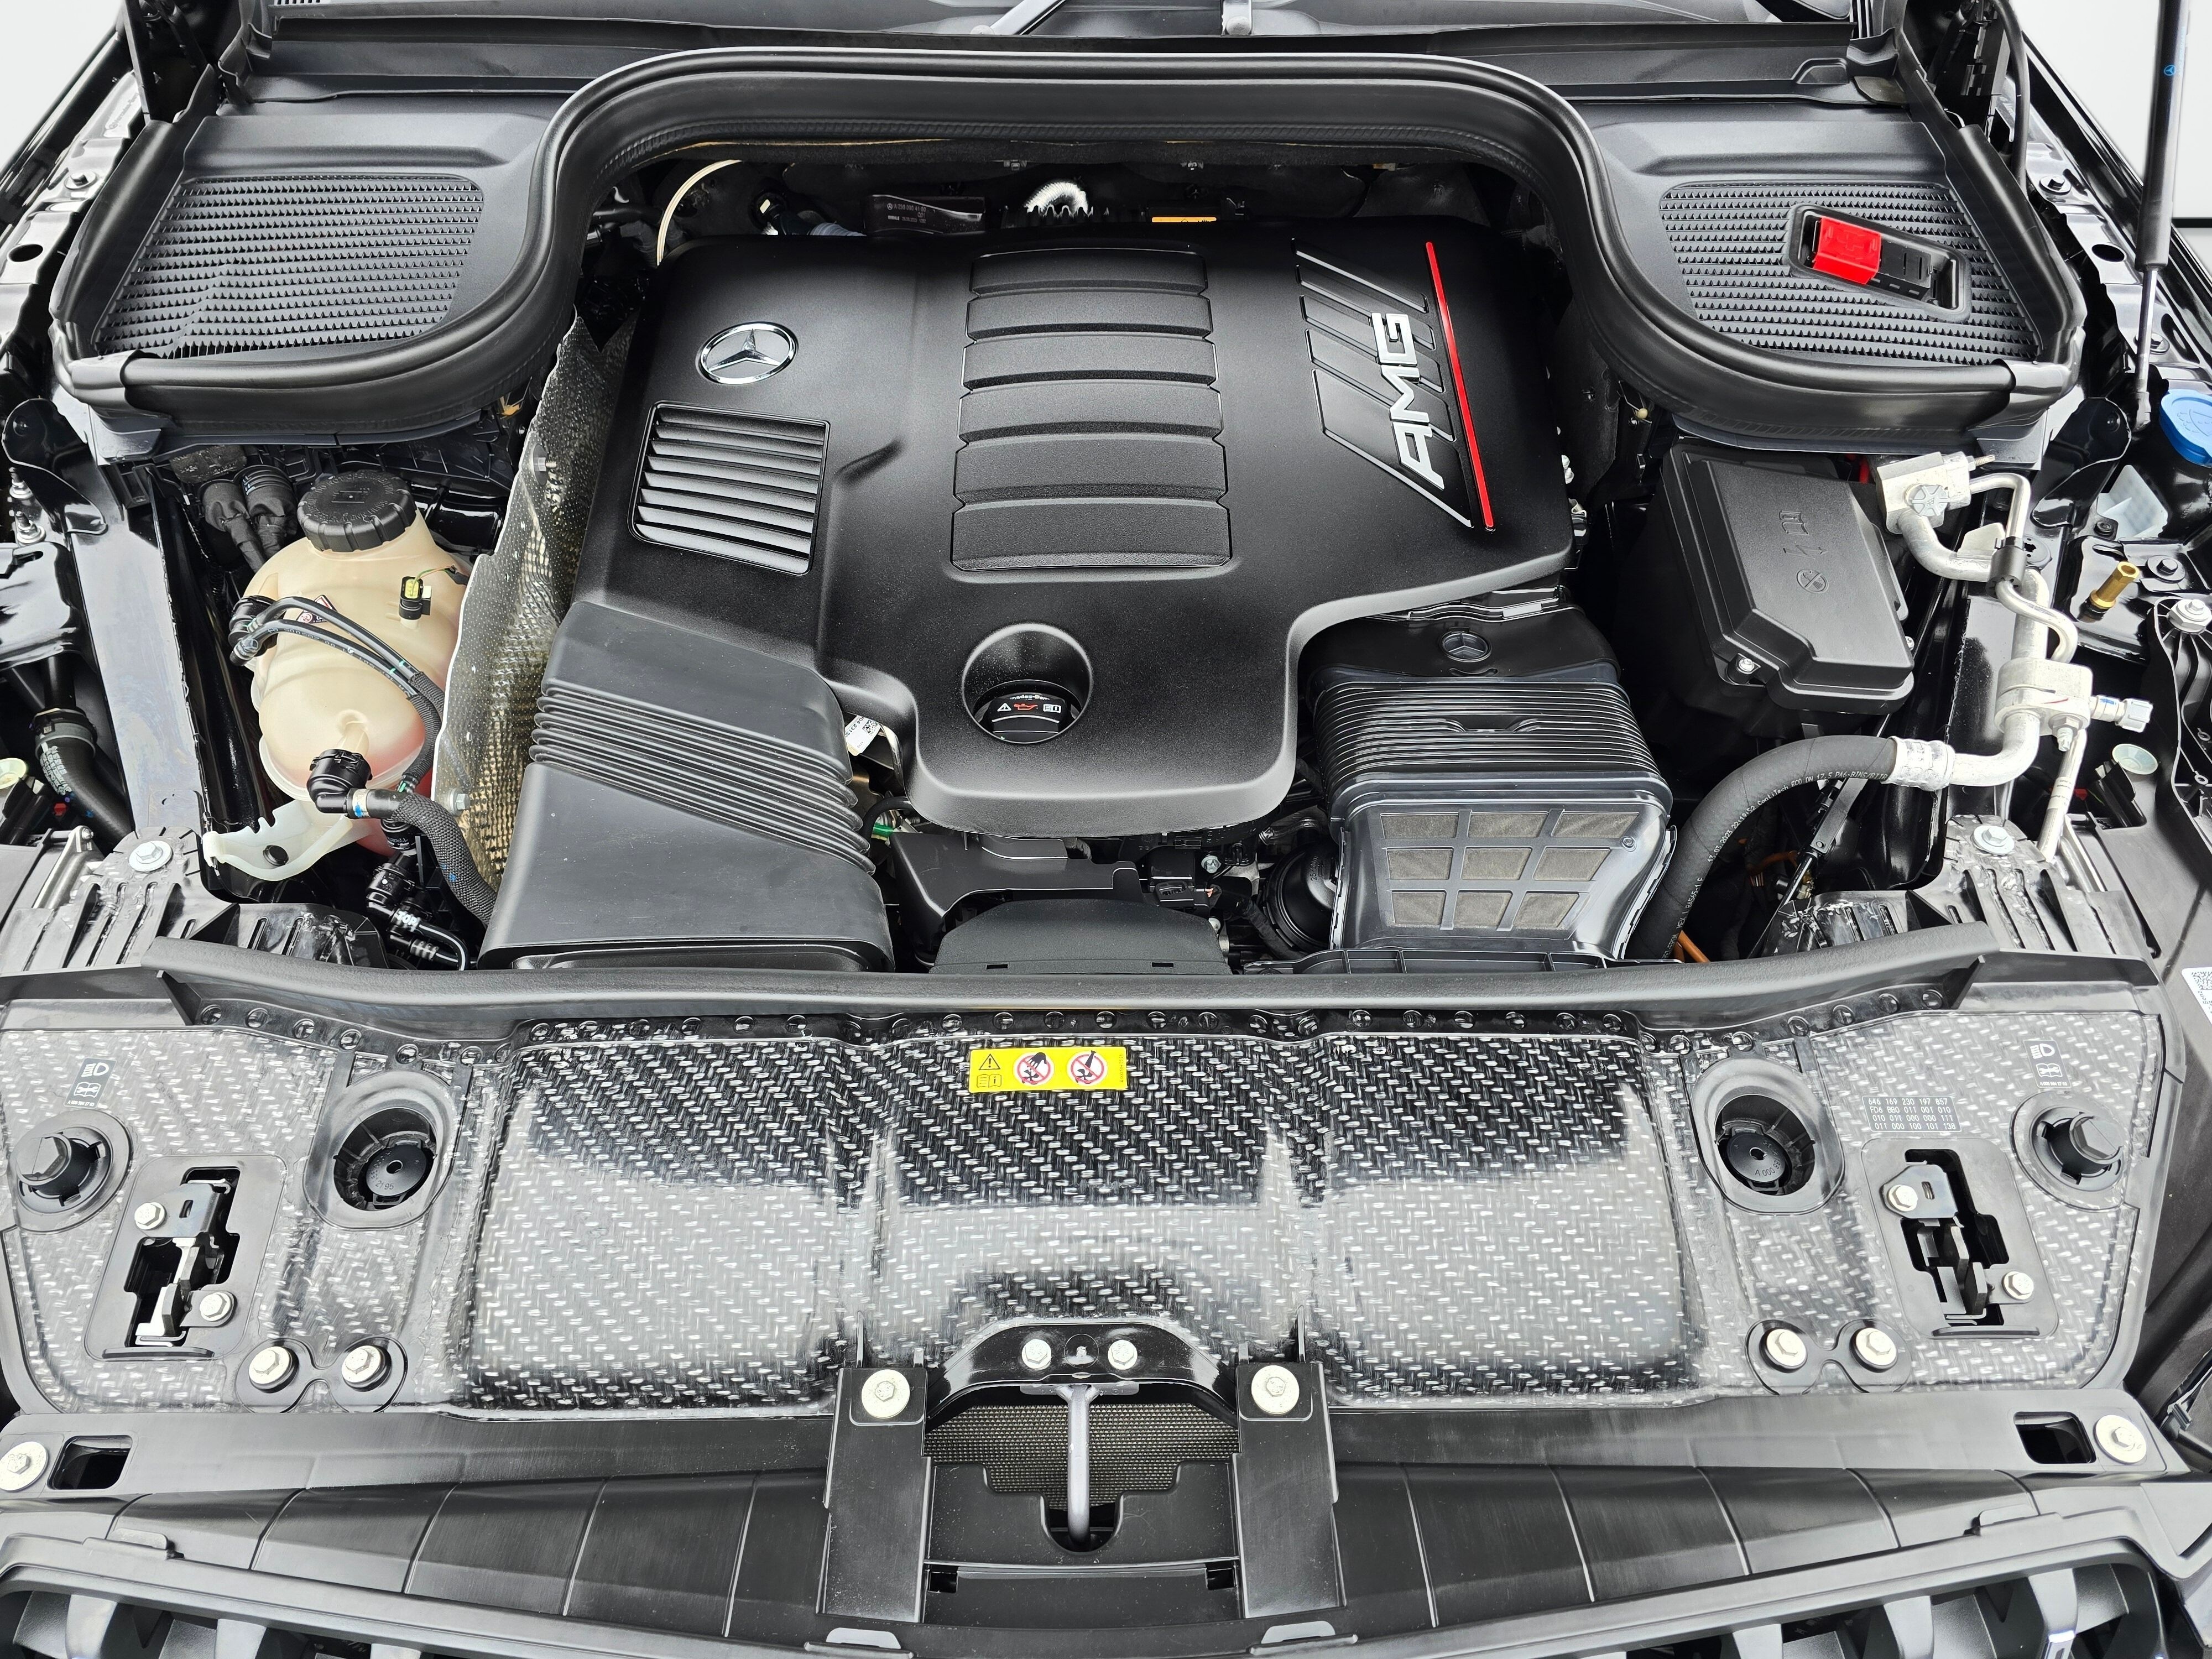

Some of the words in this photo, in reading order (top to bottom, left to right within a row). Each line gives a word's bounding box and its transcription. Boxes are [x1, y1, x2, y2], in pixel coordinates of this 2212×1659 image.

[1371, 312, 1445, 490] AMG
[1707, 830, 1733, 863] 13.03.2023
[1731, 805, 1756, 830] 22:19:52
[1757, 785, 1789, 806] ContiTech
[1791, 778, 1803, 787] ECO
[1816, 771, 1833, 780] 17.5
[1762, 1167, 1775, 1176] 000
